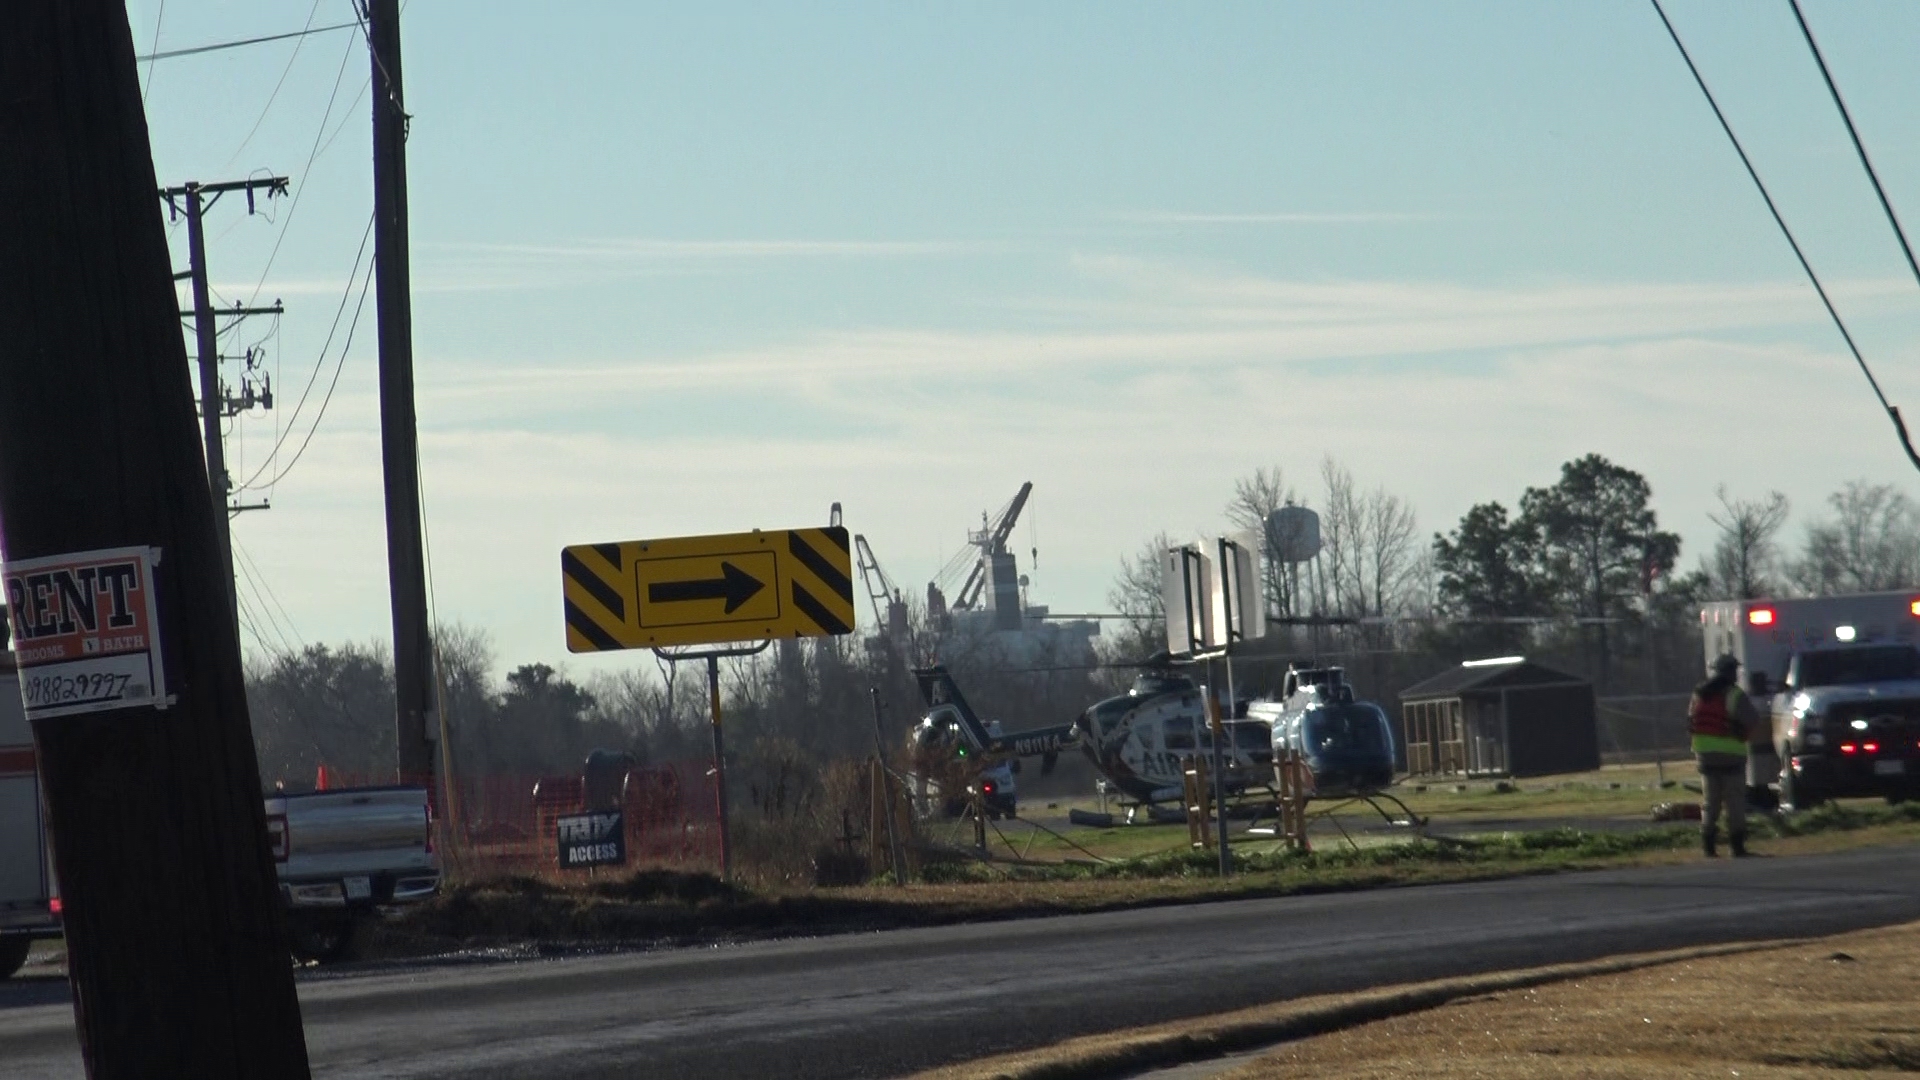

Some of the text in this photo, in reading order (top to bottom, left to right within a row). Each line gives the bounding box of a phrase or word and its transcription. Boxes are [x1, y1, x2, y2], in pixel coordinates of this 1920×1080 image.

[8, 562, 138, 641] RENT
[104, 636, 144, 651] BATH
[569, 843, 616, 862] ACCESS
